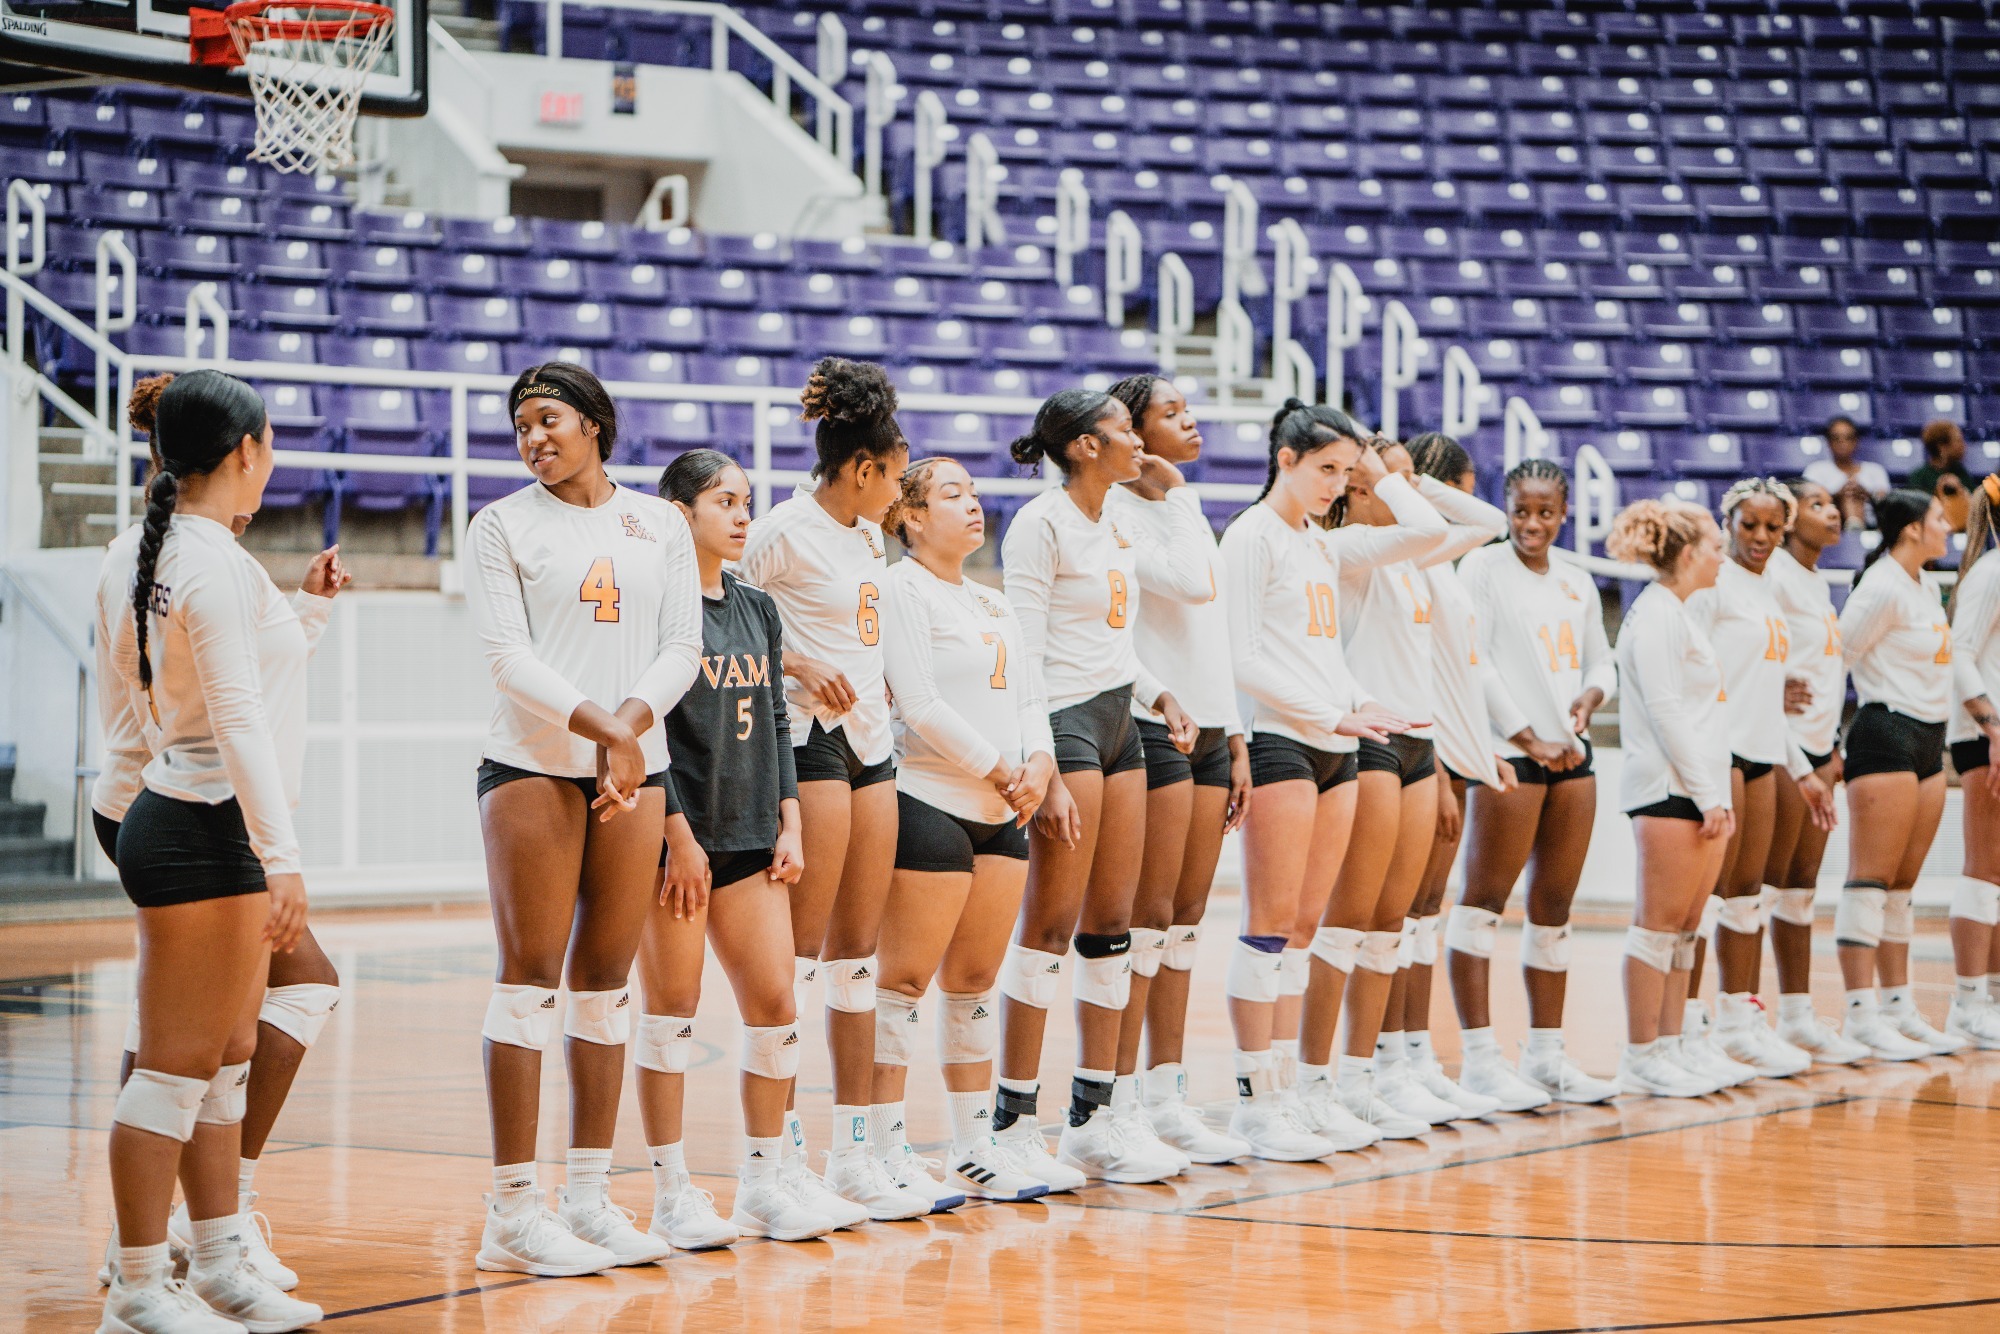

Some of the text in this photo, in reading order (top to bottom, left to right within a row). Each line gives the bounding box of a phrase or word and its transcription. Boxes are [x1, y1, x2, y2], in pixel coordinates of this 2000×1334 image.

[2, 16, 47, 36] SPALDING
[518, 384, 561, 400] Ossilee
[580, 556, 620, 623] 4
[857, 581, 879, 646] 6
[1107, 569, 1127, 629] 8
[1306, 580, 1337, 638] 10
[980, 631, 1007, 690] 7
[1538, 620, 1580, 672] 14
[1764, 616, 1789, 664] 16
[736, 695, 753, 741] 5
